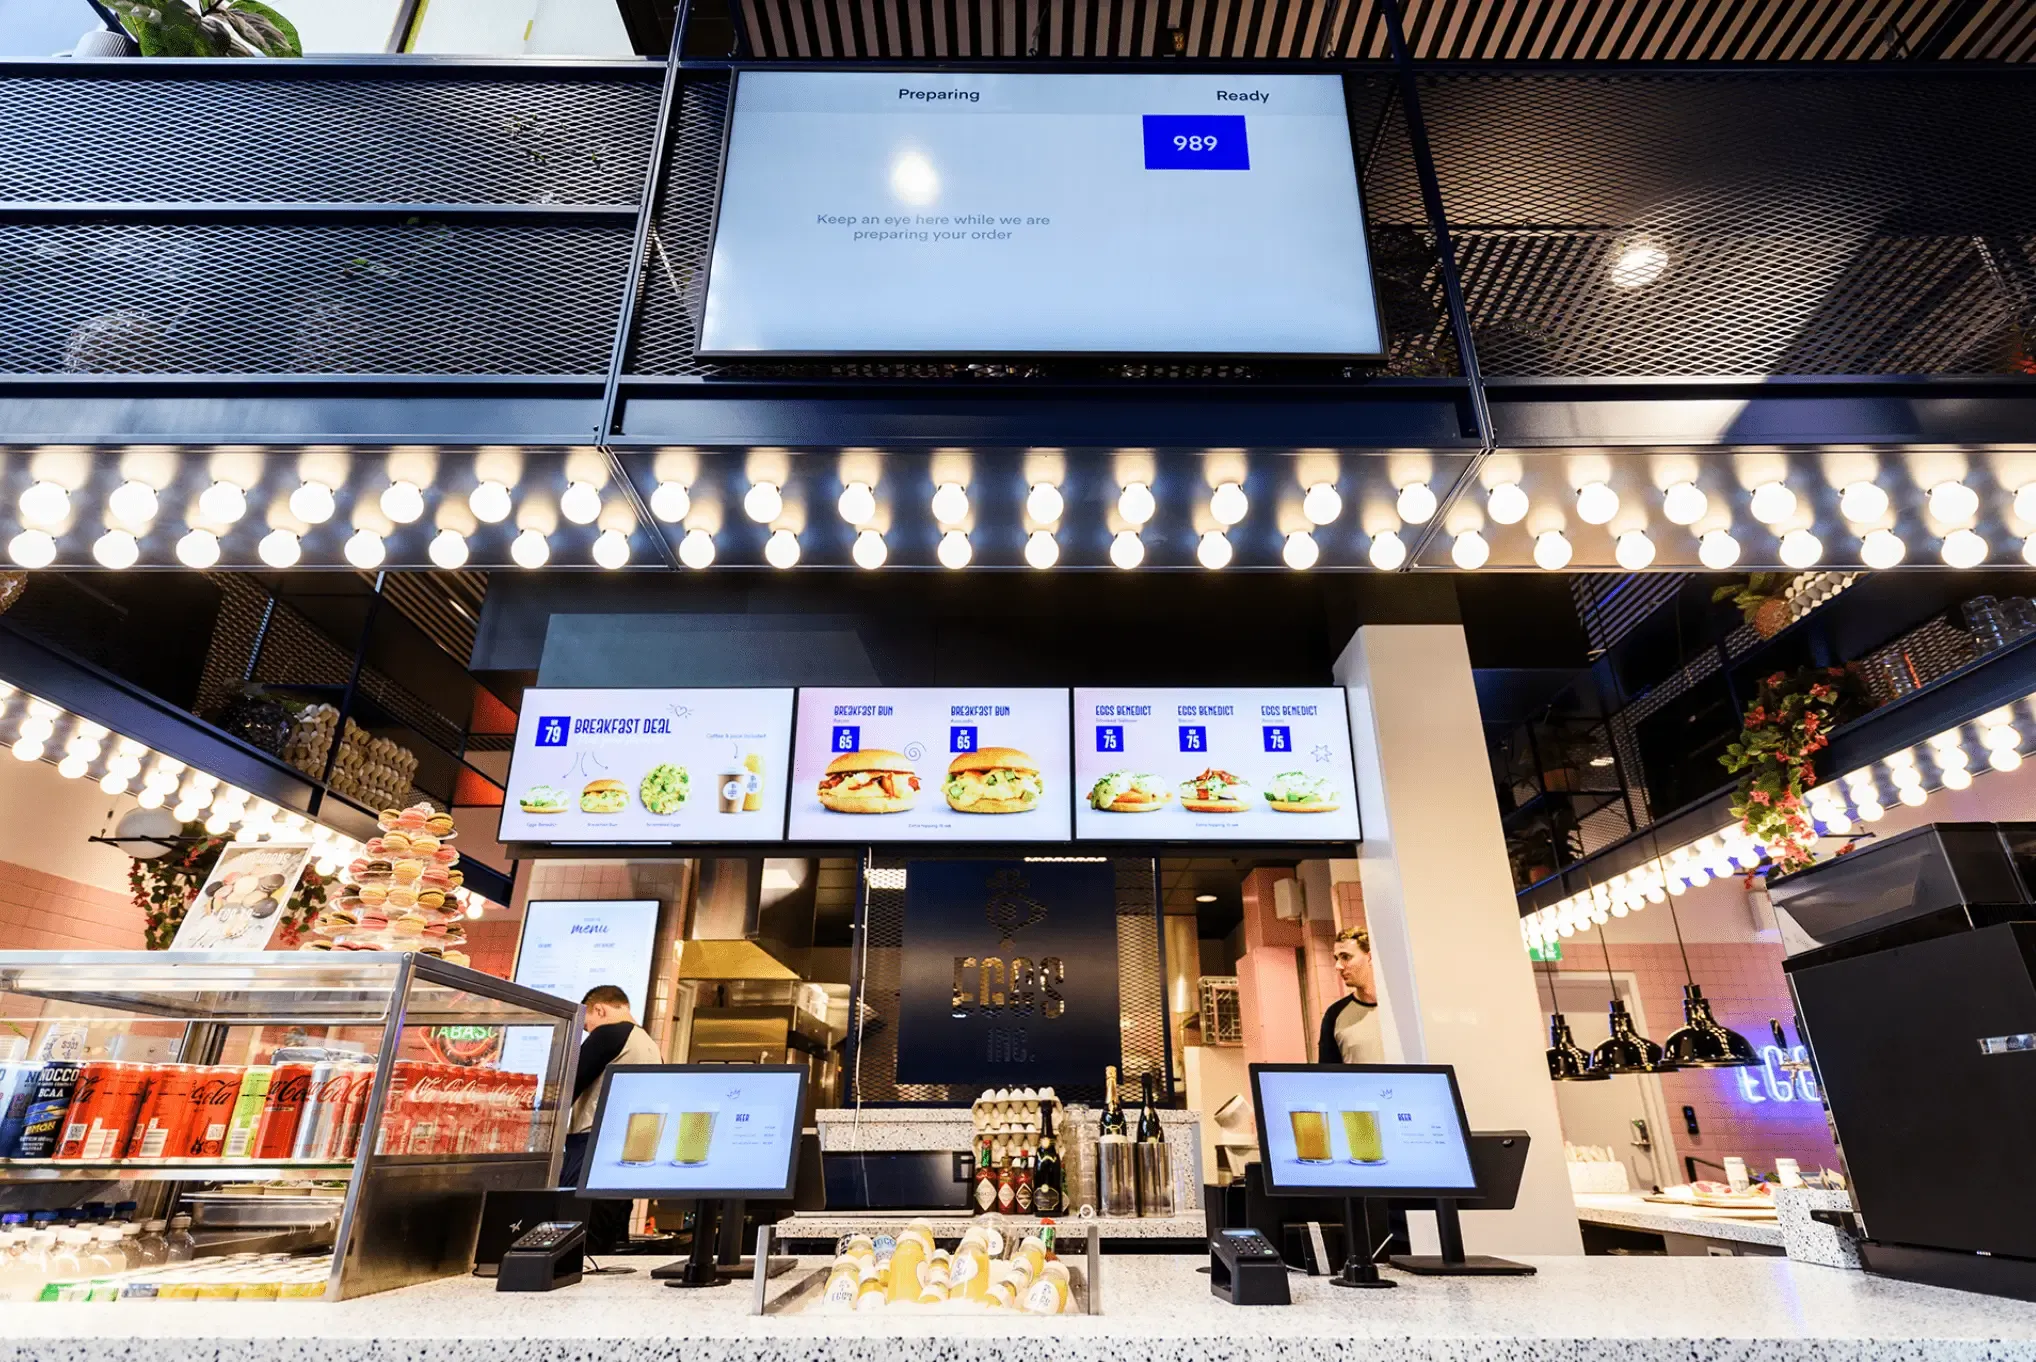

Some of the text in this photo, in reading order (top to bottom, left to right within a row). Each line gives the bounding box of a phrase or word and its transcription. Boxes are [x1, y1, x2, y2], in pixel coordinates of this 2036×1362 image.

[899, 88, 980, 103] Preparing
[1216, 89, 1270, 104] Ready
[1173, 135, 1218, 152] 989
[817, 213, 1050, 227] Keep an eye here while we are
[853, 228, 1012, 242] preparing your order
[878, 705, 894, 717] BUN
[995, 705, 1011, 717] BUN
[1095, 705, 1152, 716] EGGS BENEDICT
[1178, 705, 1234, 716] EGGS BENEDICT
[1261, 705, 1318, 716] EGGS BENEDICT
[643, 718, 671, 734] DEAL
[545, 726, 561, 744] 79
[839, 735, 853, 749] 65
[957, 735, 970, 749] 65
[1103, 735, 1116, 749] 75
[1186, 735, 1200, 749] 75
[1271, 735, 1284, 749] 75
[952, 956, 1065, 1019] EGGS
[39, 1067, 80, 1082] NOCCO
[38, 1087, 64, 1098] BCAA
